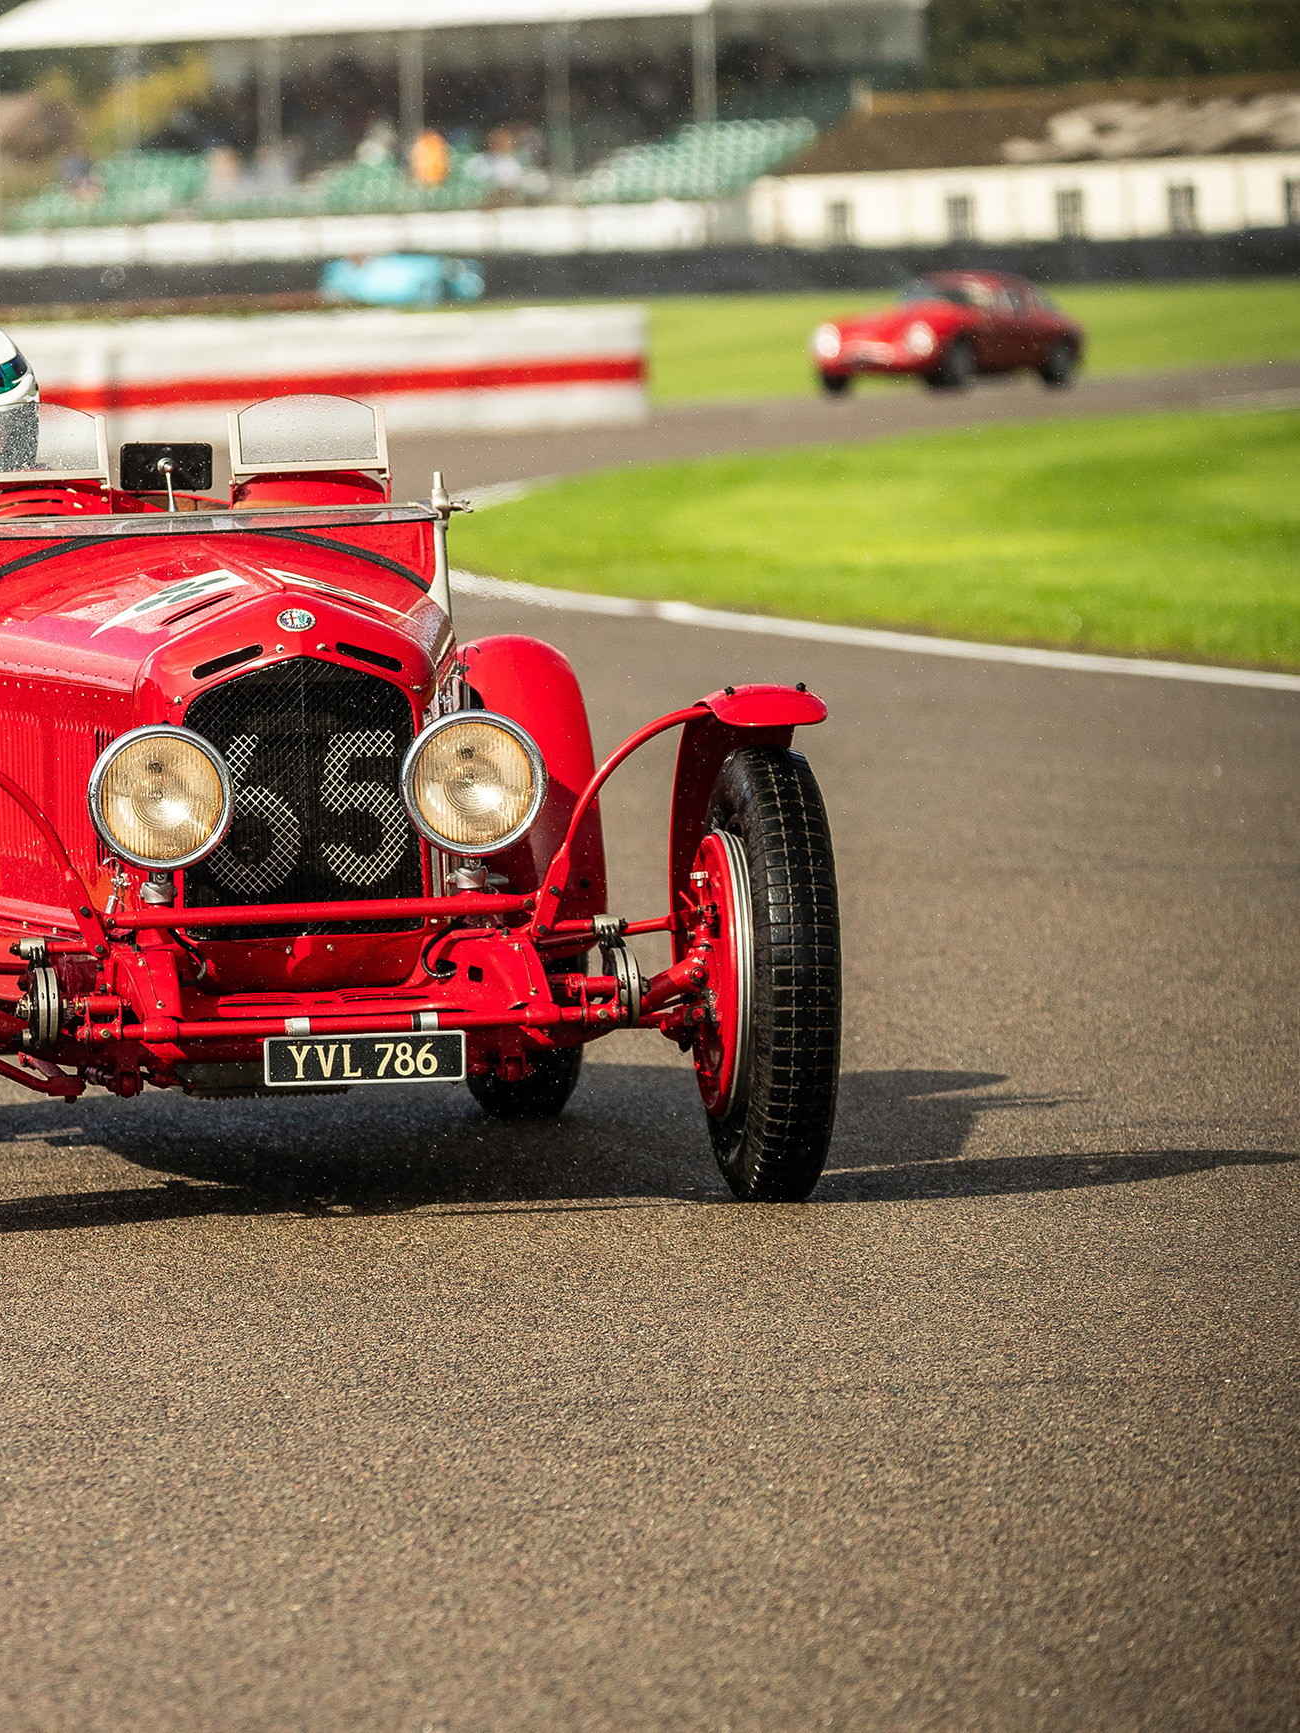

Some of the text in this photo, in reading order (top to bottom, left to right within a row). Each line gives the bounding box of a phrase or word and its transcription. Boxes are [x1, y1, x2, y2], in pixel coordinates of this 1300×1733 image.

[207, 730, 409, 894] 65
[287, 1042, 438, 1078] YVL 786
